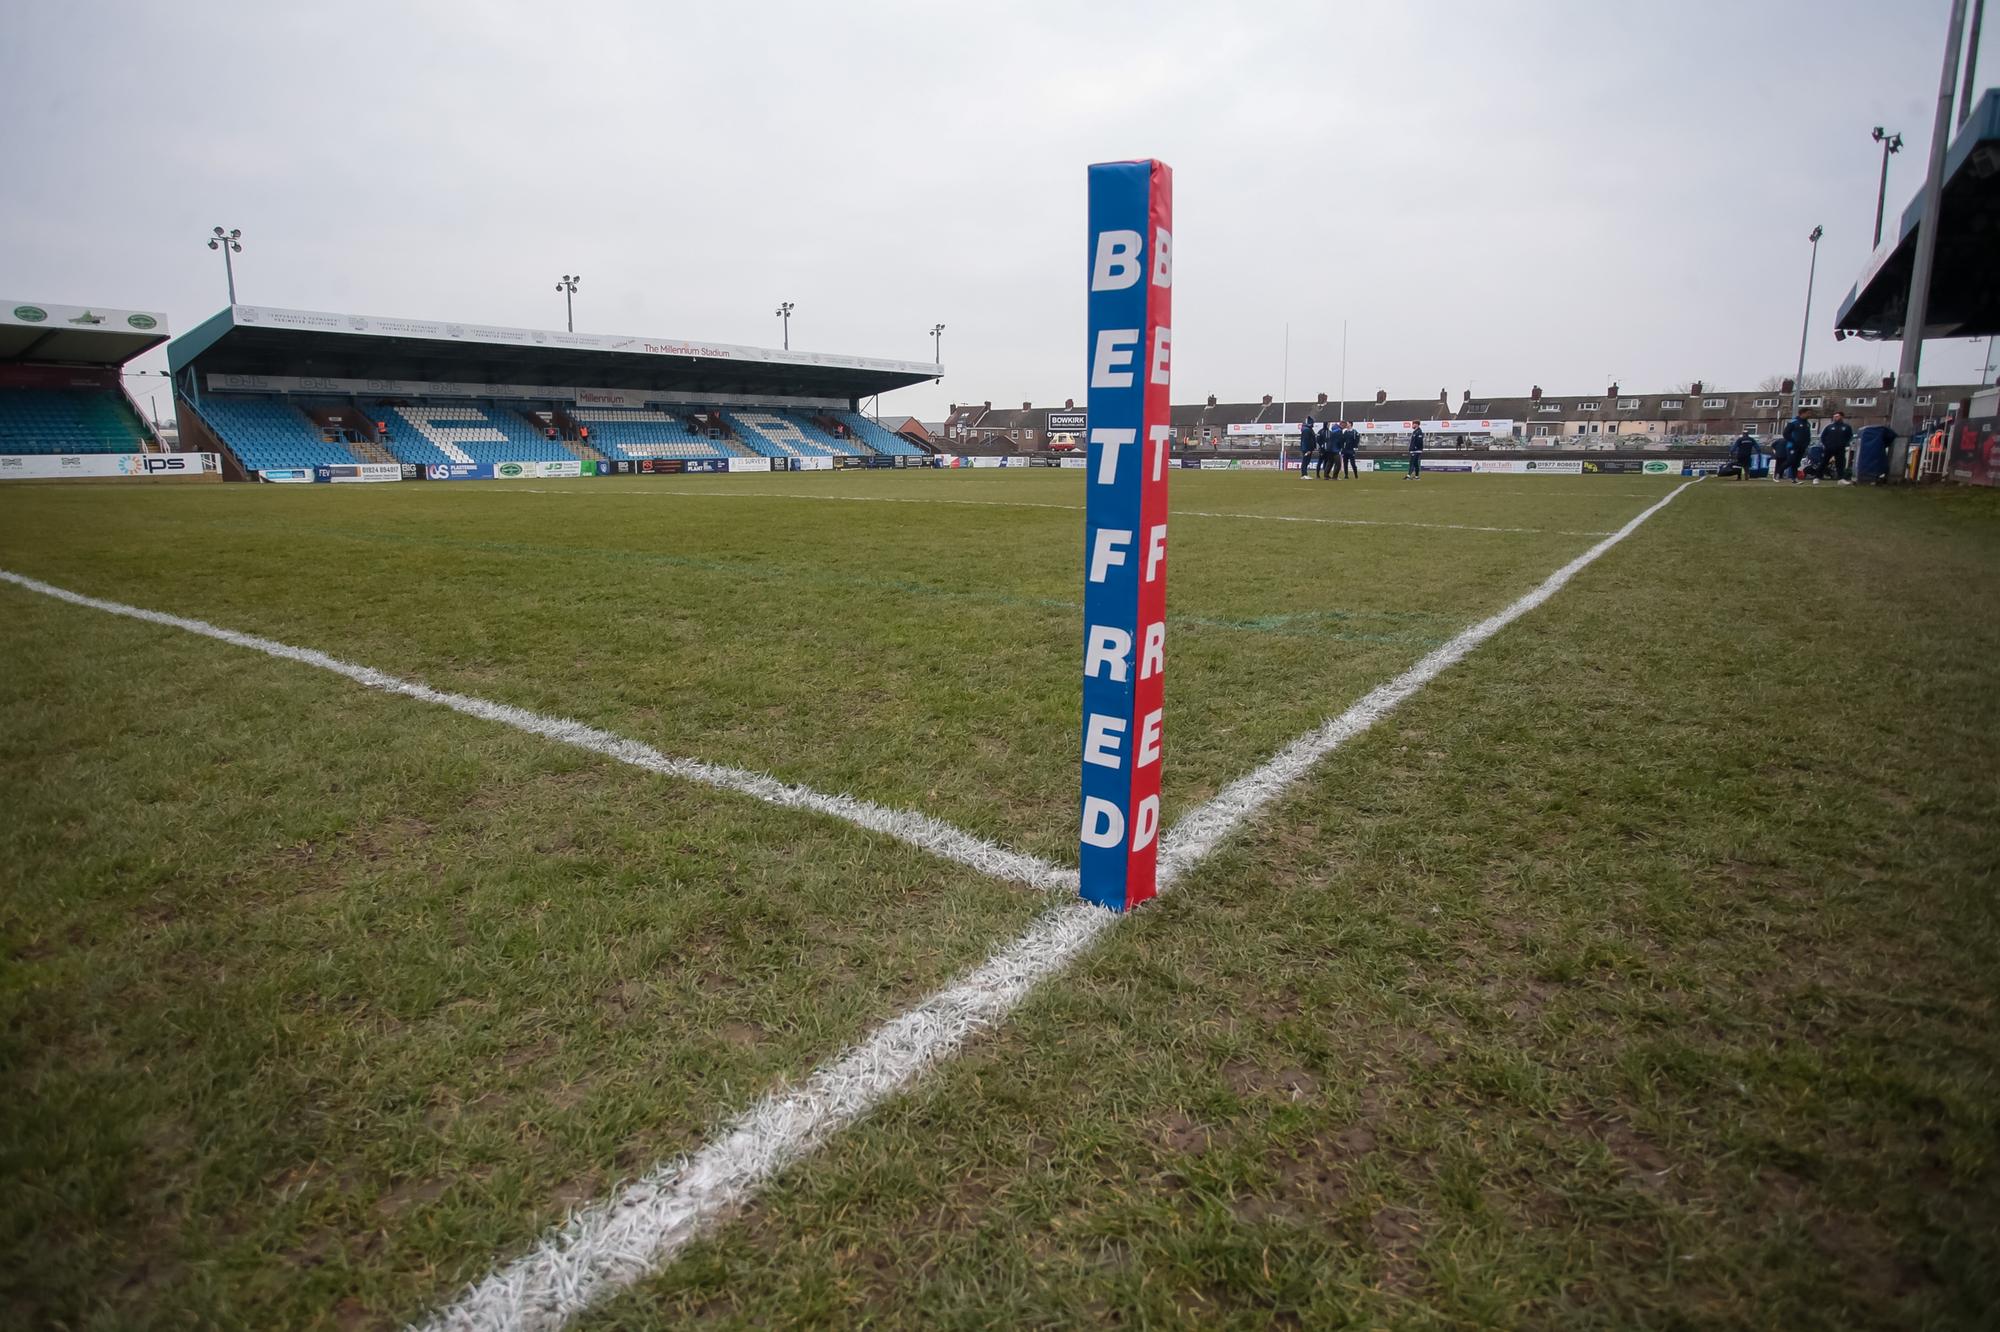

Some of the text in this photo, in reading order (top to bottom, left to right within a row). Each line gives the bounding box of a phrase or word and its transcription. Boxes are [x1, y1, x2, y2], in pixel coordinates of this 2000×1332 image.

[644, 343, 659, 353] The
[660, 344, 700, 355] Millennium
[701, 347, 730, 358] Stadium
[579, 391, 625, 404] Millennium
[1052, 416, 1085, 424] BOWKIRK
[143, 455, 186, 473] ips
[402, 463, 416, 472] BIG
[774, 457, 785, 465] BIG
[1080, 229, 1143, 849] BETFRED
[1131, 226, 1173, 853] BETFRED
